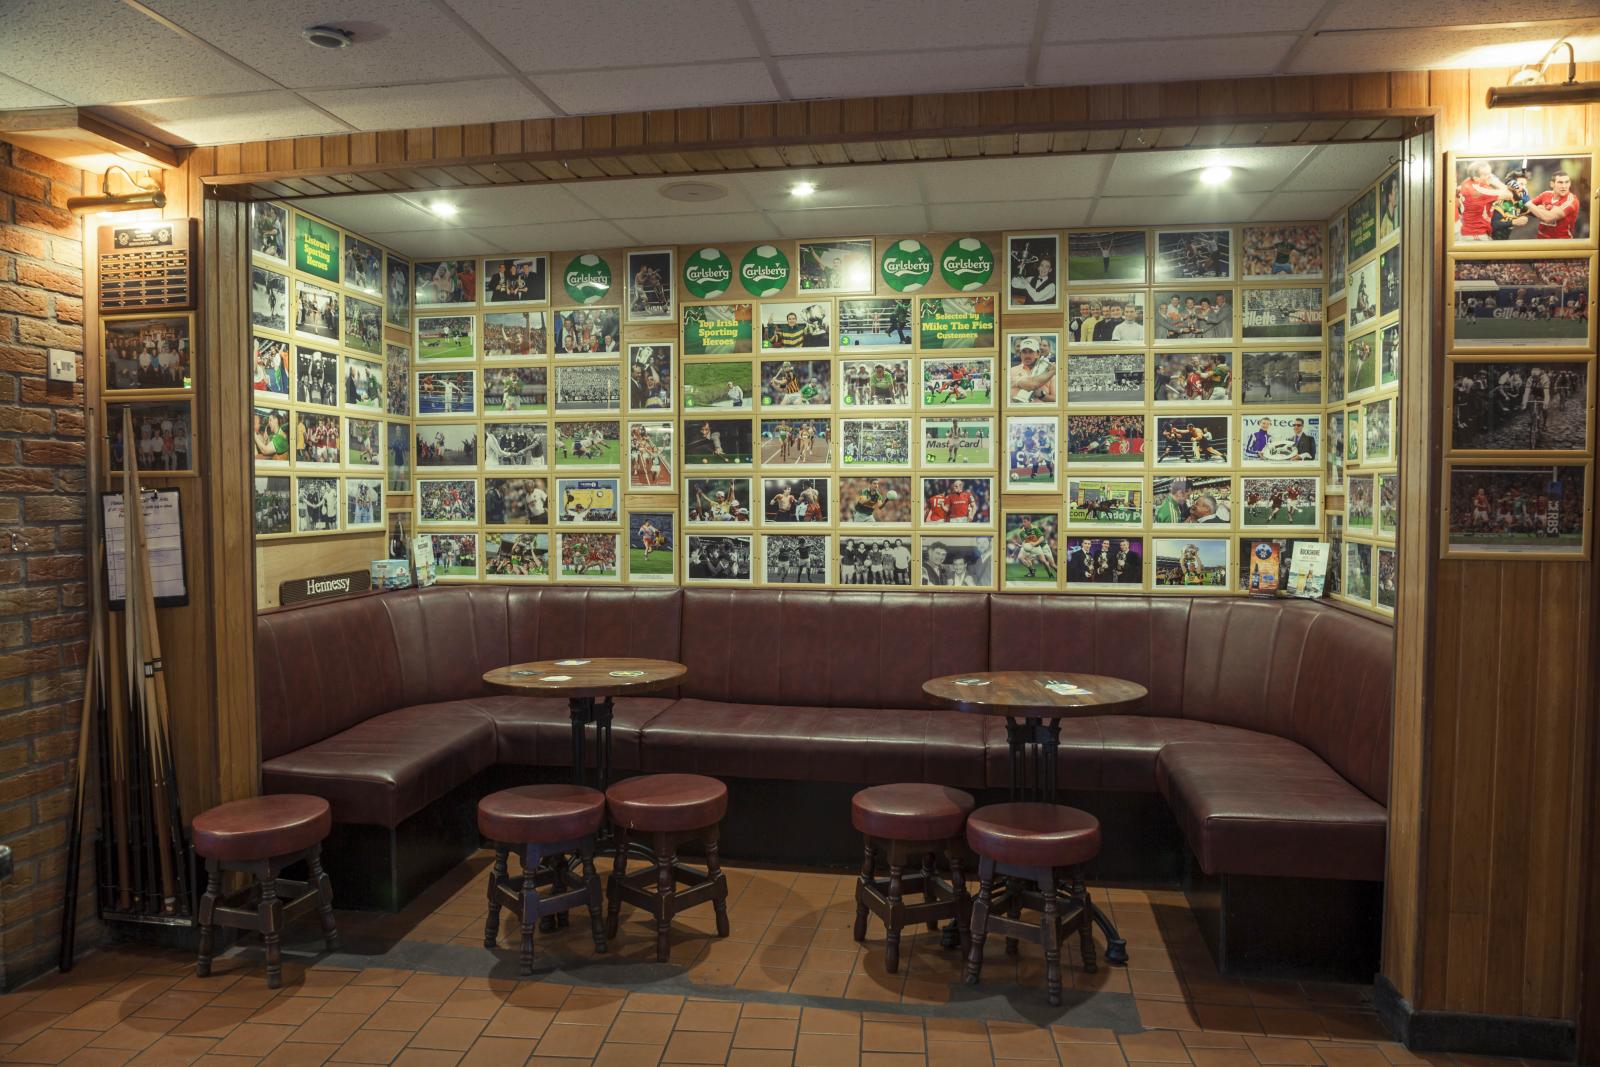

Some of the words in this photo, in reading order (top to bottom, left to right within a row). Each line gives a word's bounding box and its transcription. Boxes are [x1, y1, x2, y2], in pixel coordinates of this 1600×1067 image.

[304, 233, 330, 251] Listowel
[304, 243, 330, 263] Sporting
[306, 254, 328, 270] Heroes
[884, 257, 930, 273] Carlsberg
[943, 256, 990, 272] Carlsberg
[566, 271, 608, 286] Carlsberg
[686, 265, 729, 281] Carlsberg
[742, 263, 786, 279] Carlsberg
[698, 319, 715, 329] Top
[716, 319, 739, 328] Irish
[970, 313, 980, 321] by
[698, 328, 738, 338] Sporting
[922, 322, 949, 331] Mike
[951, 321, 970, 330] The
[972, 320, 993, 330] Pies
[702, 338, 735, 346] Heroes
[1546, 511, 1560, 535] RBS
[306, 577, 350, 595] Hennessy
